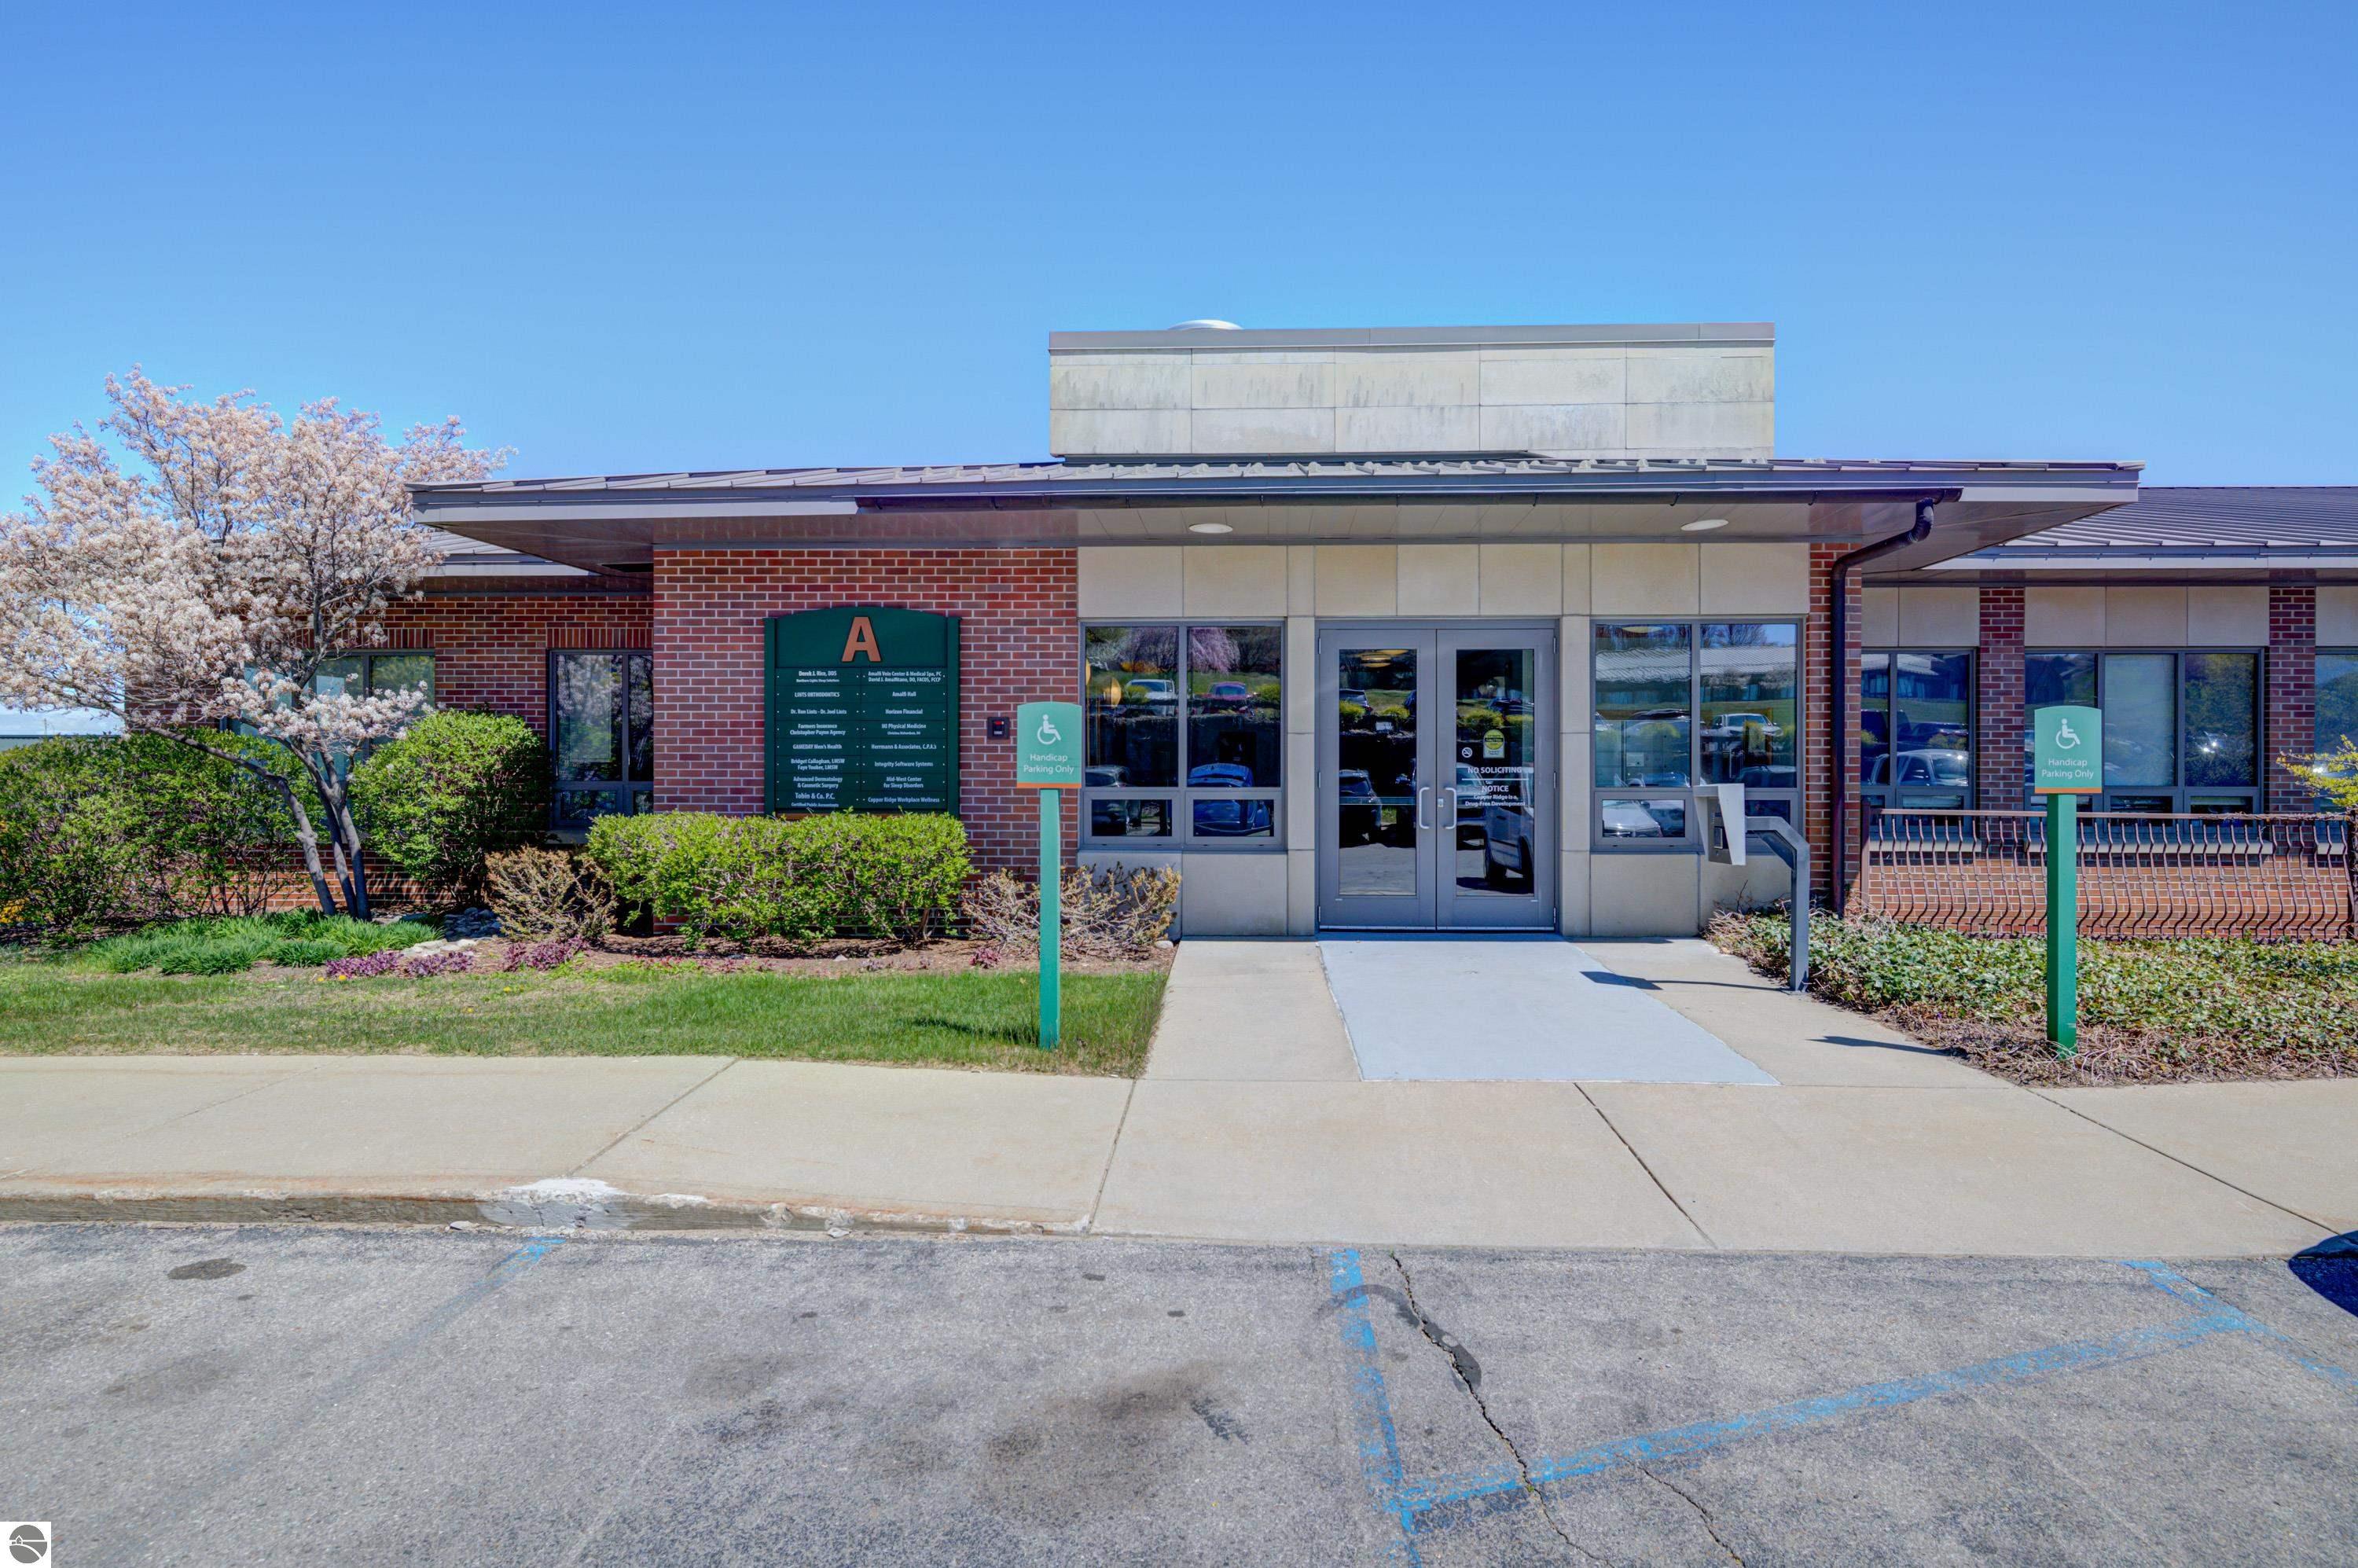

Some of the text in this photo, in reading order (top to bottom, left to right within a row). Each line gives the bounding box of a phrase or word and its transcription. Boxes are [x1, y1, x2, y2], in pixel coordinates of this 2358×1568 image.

[842, 617, 881, 662] A
[1030, 754, 1068, 762] Handicap
[2048, 758, 2088, 767] Handicap
[1023, 765, 1074, 774] Parking Only
[2042, 769, 2094, 779] Parking Only
